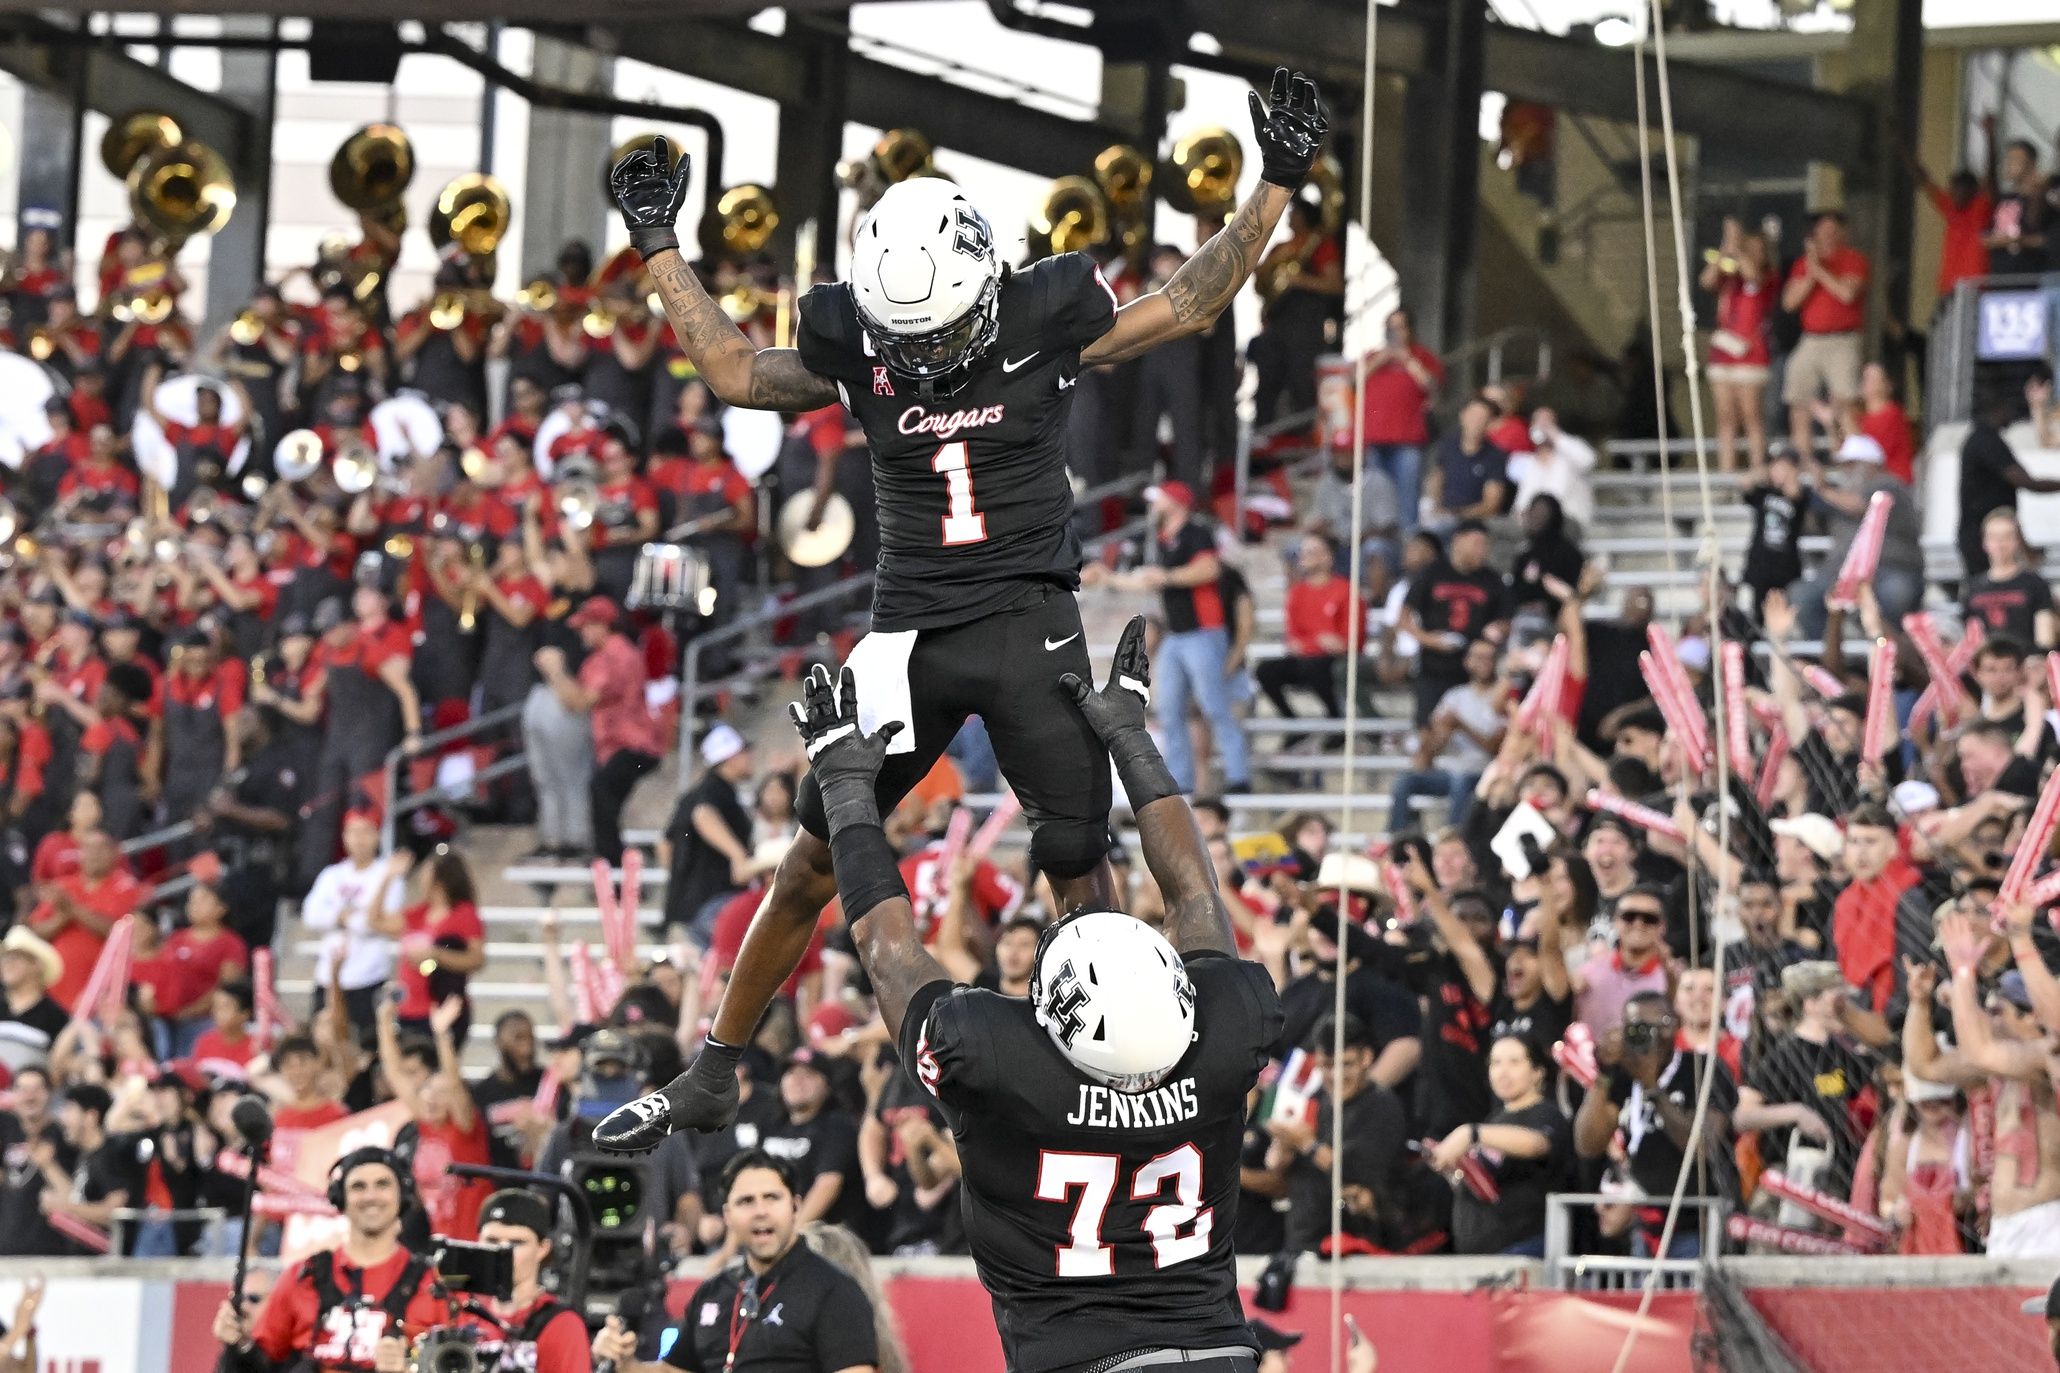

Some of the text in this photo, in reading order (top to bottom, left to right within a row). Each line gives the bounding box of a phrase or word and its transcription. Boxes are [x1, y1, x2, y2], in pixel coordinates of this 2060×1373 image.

[891, 316, 932, 325] HOUSTON
[897, 404, 1004, 439] Cougars
[931, 440, 988, 545] 1
[1066, 1077, 1199, 1128] JENKINS
[1033, 1140, 1215, 1278] 72
